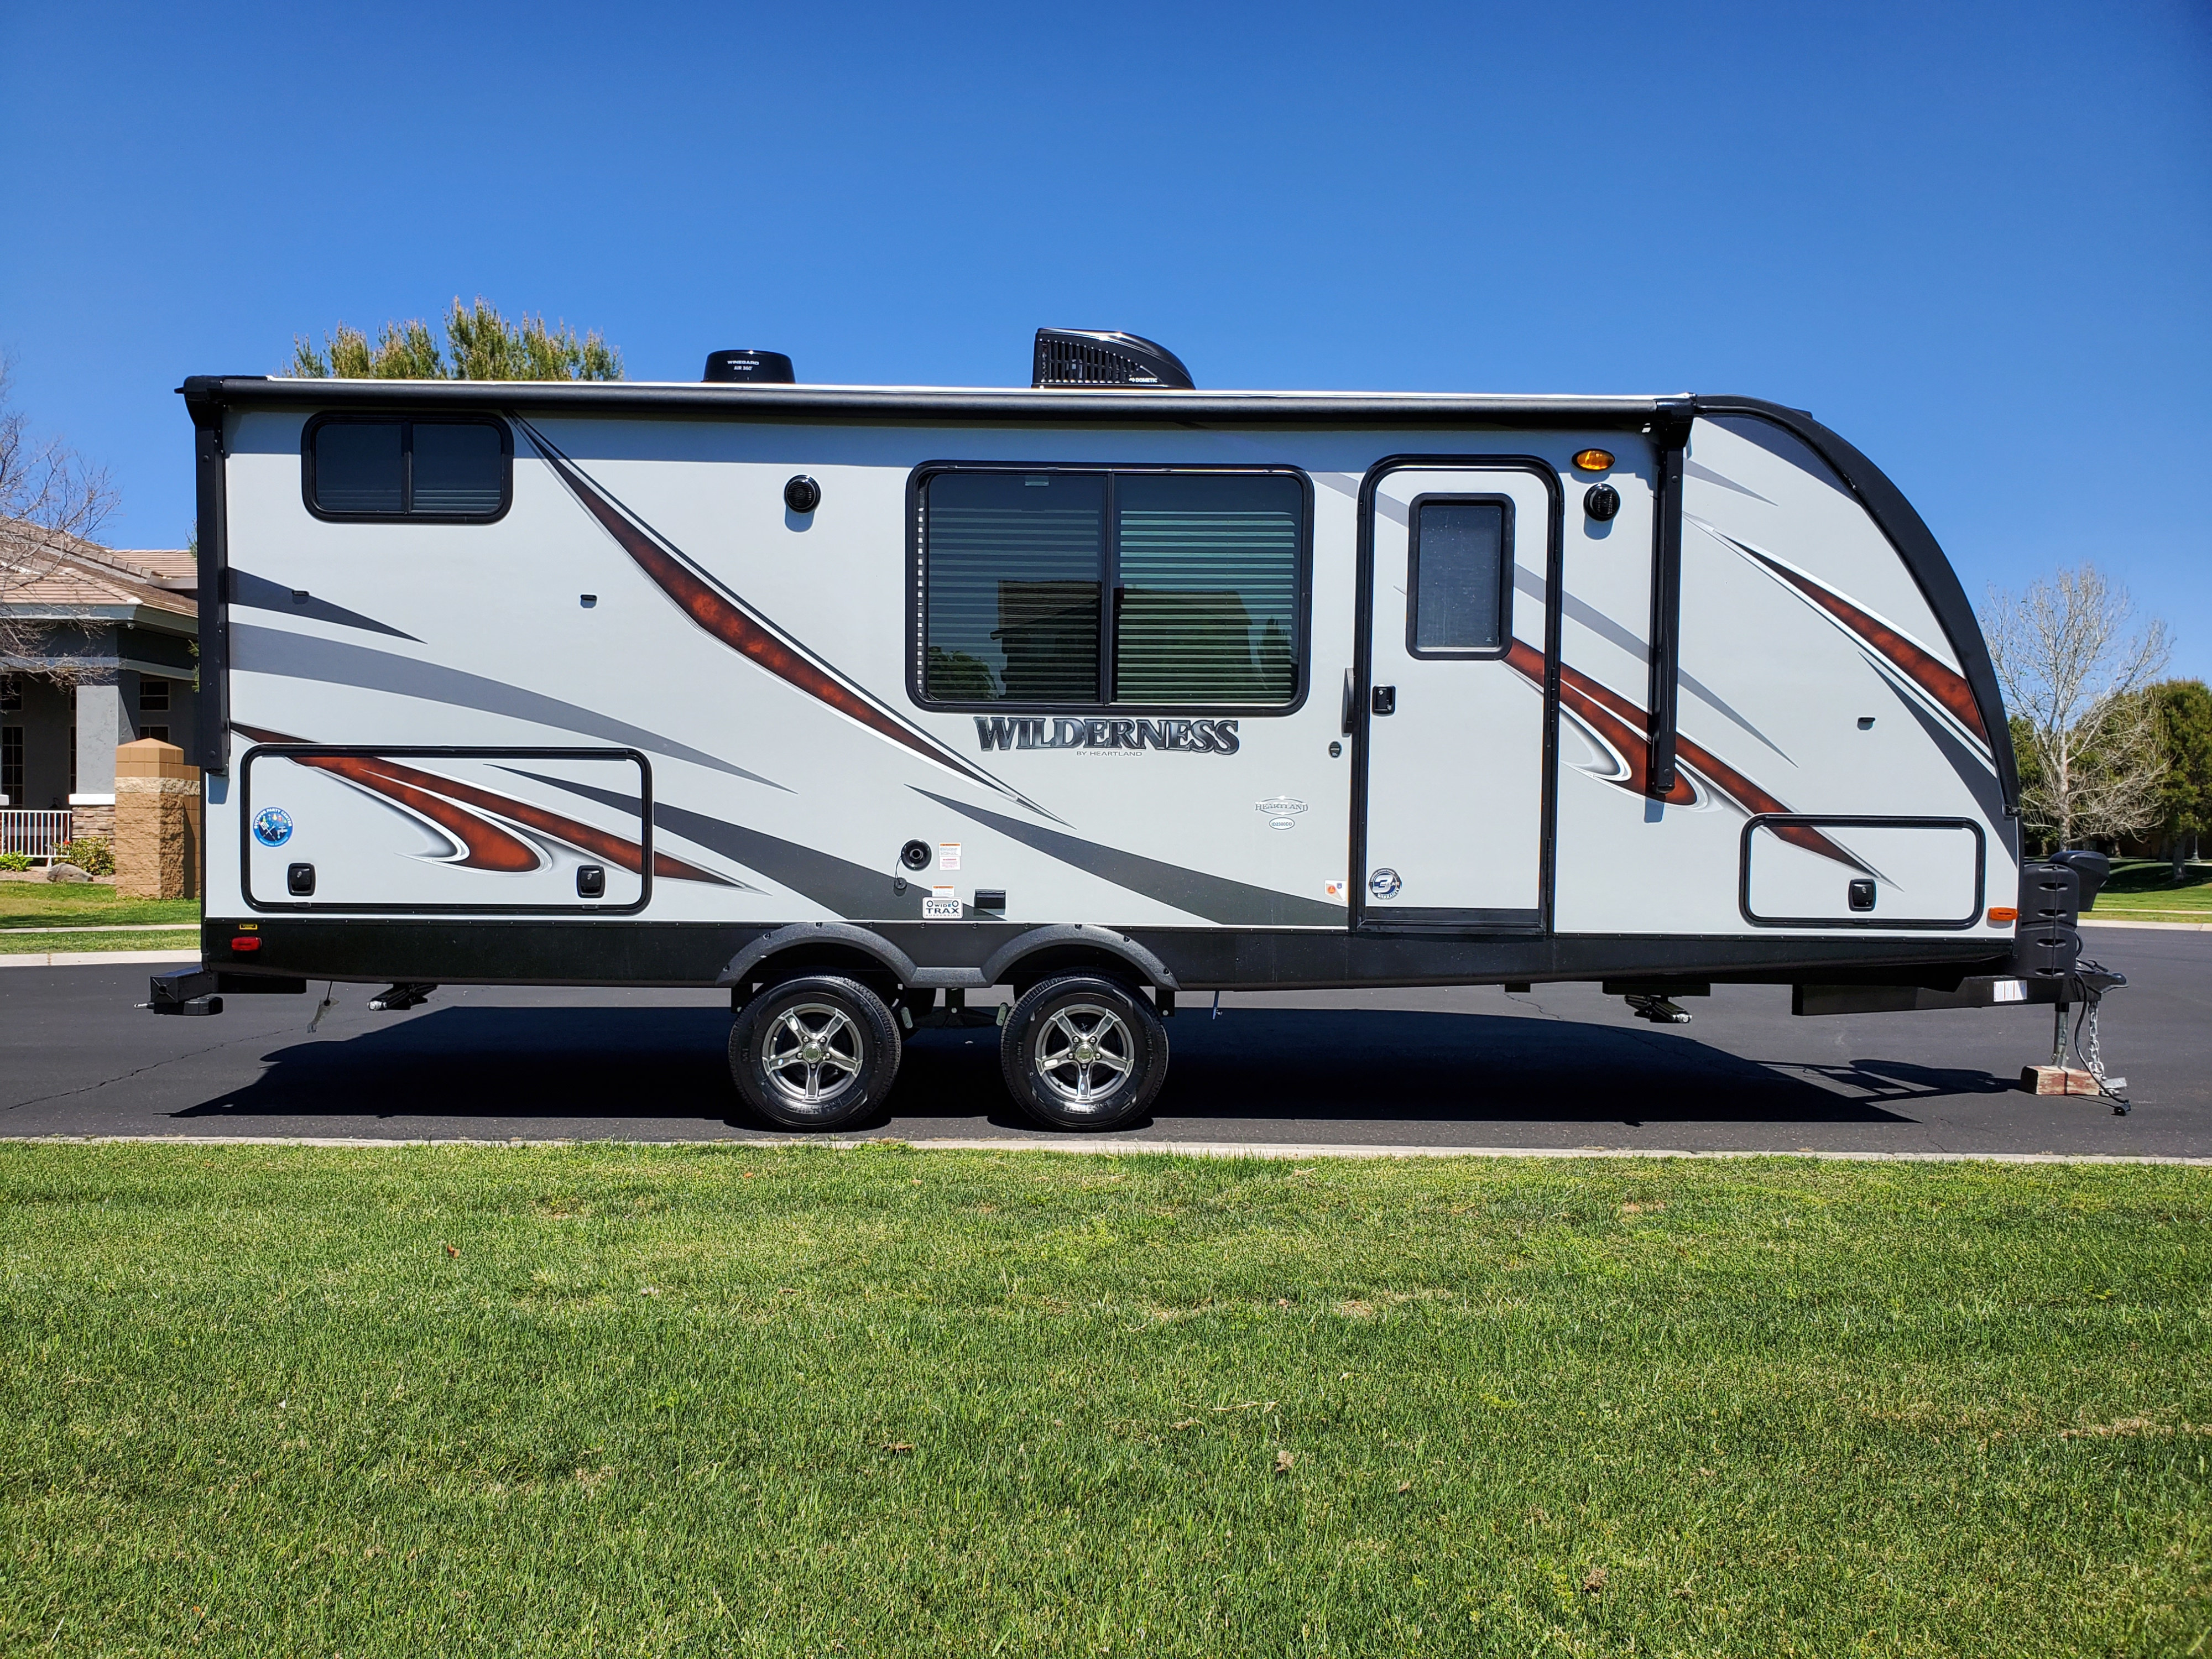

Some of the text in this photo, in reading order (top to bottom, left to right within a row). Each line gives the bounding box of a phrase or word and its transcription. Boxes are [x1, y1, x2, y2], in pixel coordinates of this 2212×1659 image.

[973, 717, 1239, 755] WILDERNESS
[1255, 802, 1308, 811] HEARTLAND
[254, 810, 267, 829] OUTDOOR
[281, 811, 292, 827] CENTER
[1372, 875, 1393, 893] 3
[1377, 887, 1400, 899] WARRANTY
